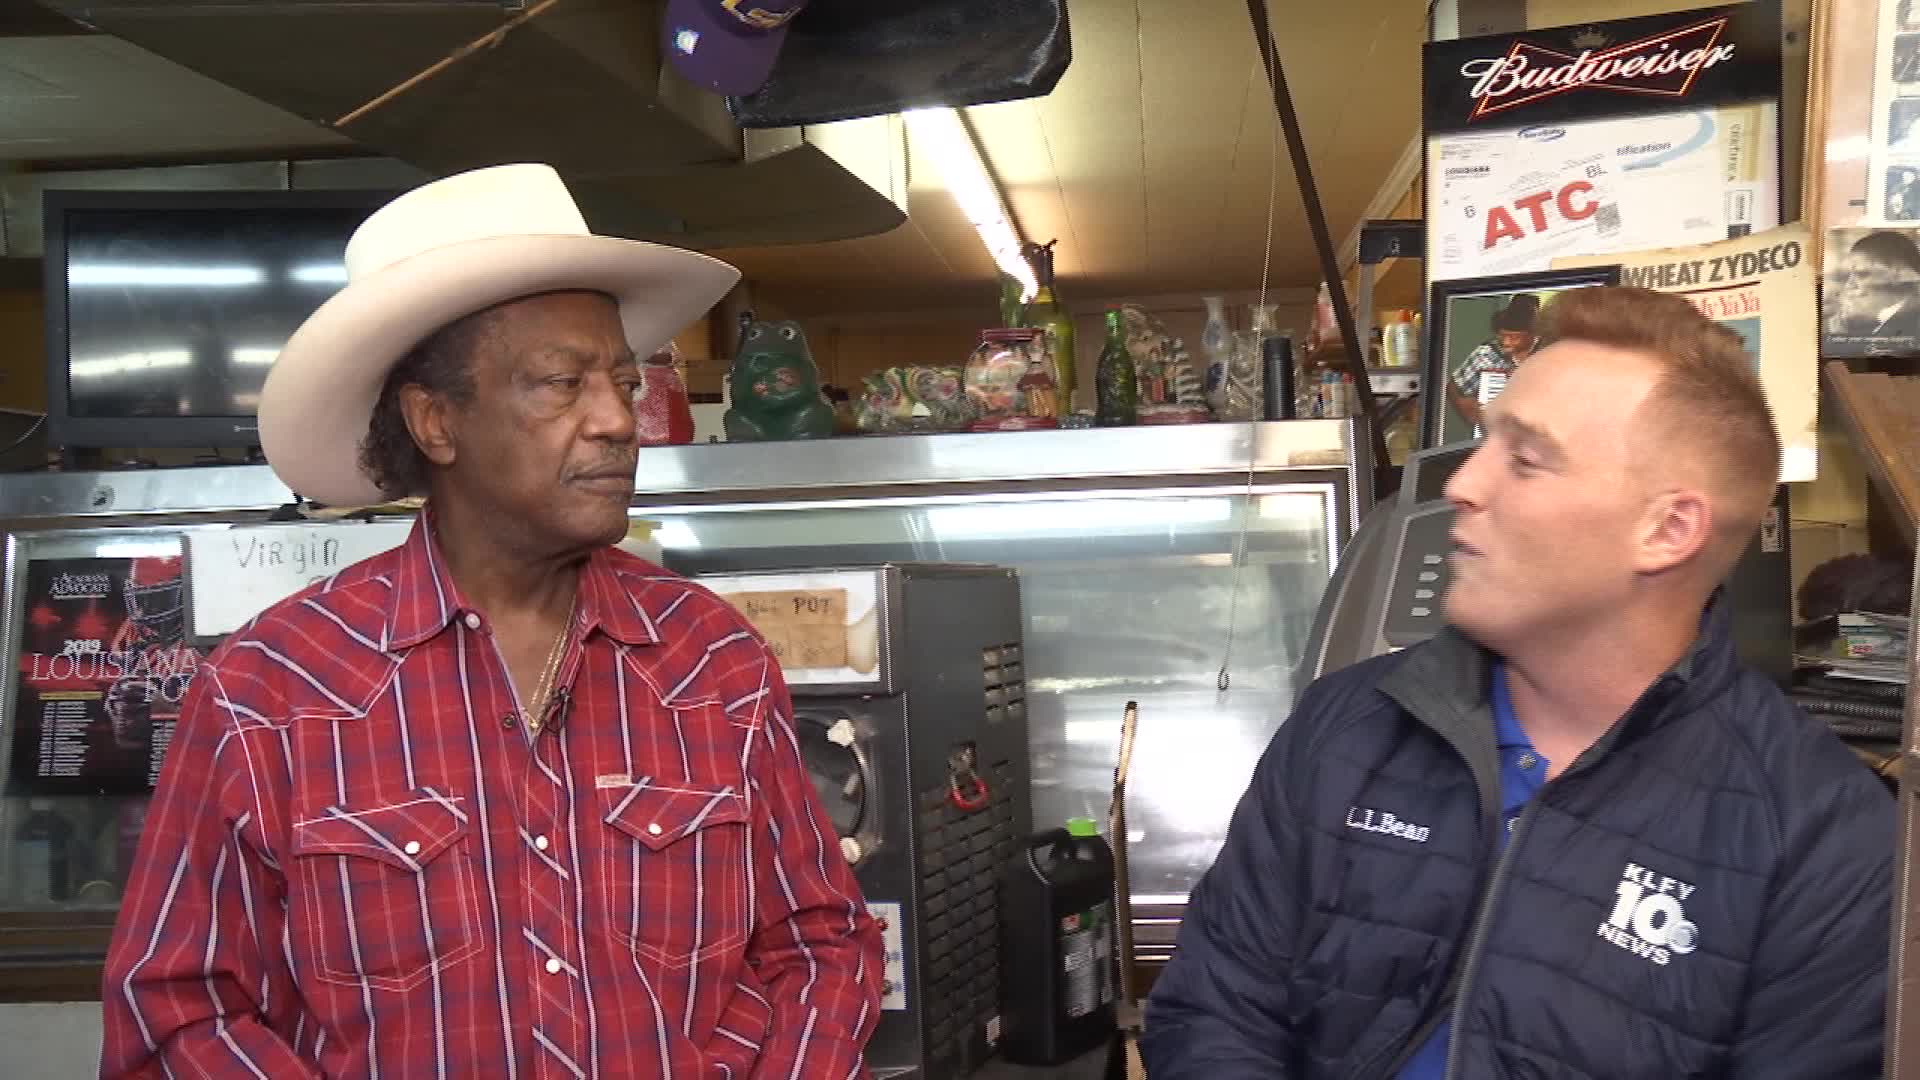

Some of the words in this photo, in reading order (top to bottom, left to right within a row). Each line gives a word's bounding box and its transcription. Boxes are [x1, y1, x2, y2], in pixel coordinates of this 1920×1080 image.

[1461, 43, 1736, 99] Budweiser
[1483, 180, 1600, 250] ATC
[1621, 261, 1704, 289] WHEAT
[1708, 241, 1801, 283] ZYDECO
[49, 581, 112, 595] ADVOCATE
[32, 648, 199, 681] LOUISIANA
[63, 639, 101, 655] 2019
[1345, 805, 1430, 842] L.L.Bean
[1622, 861, 1696, 900] KLFY
[1608, 880, 1685, 946] 10
[1597, 921, 1671, 965] NEWS
